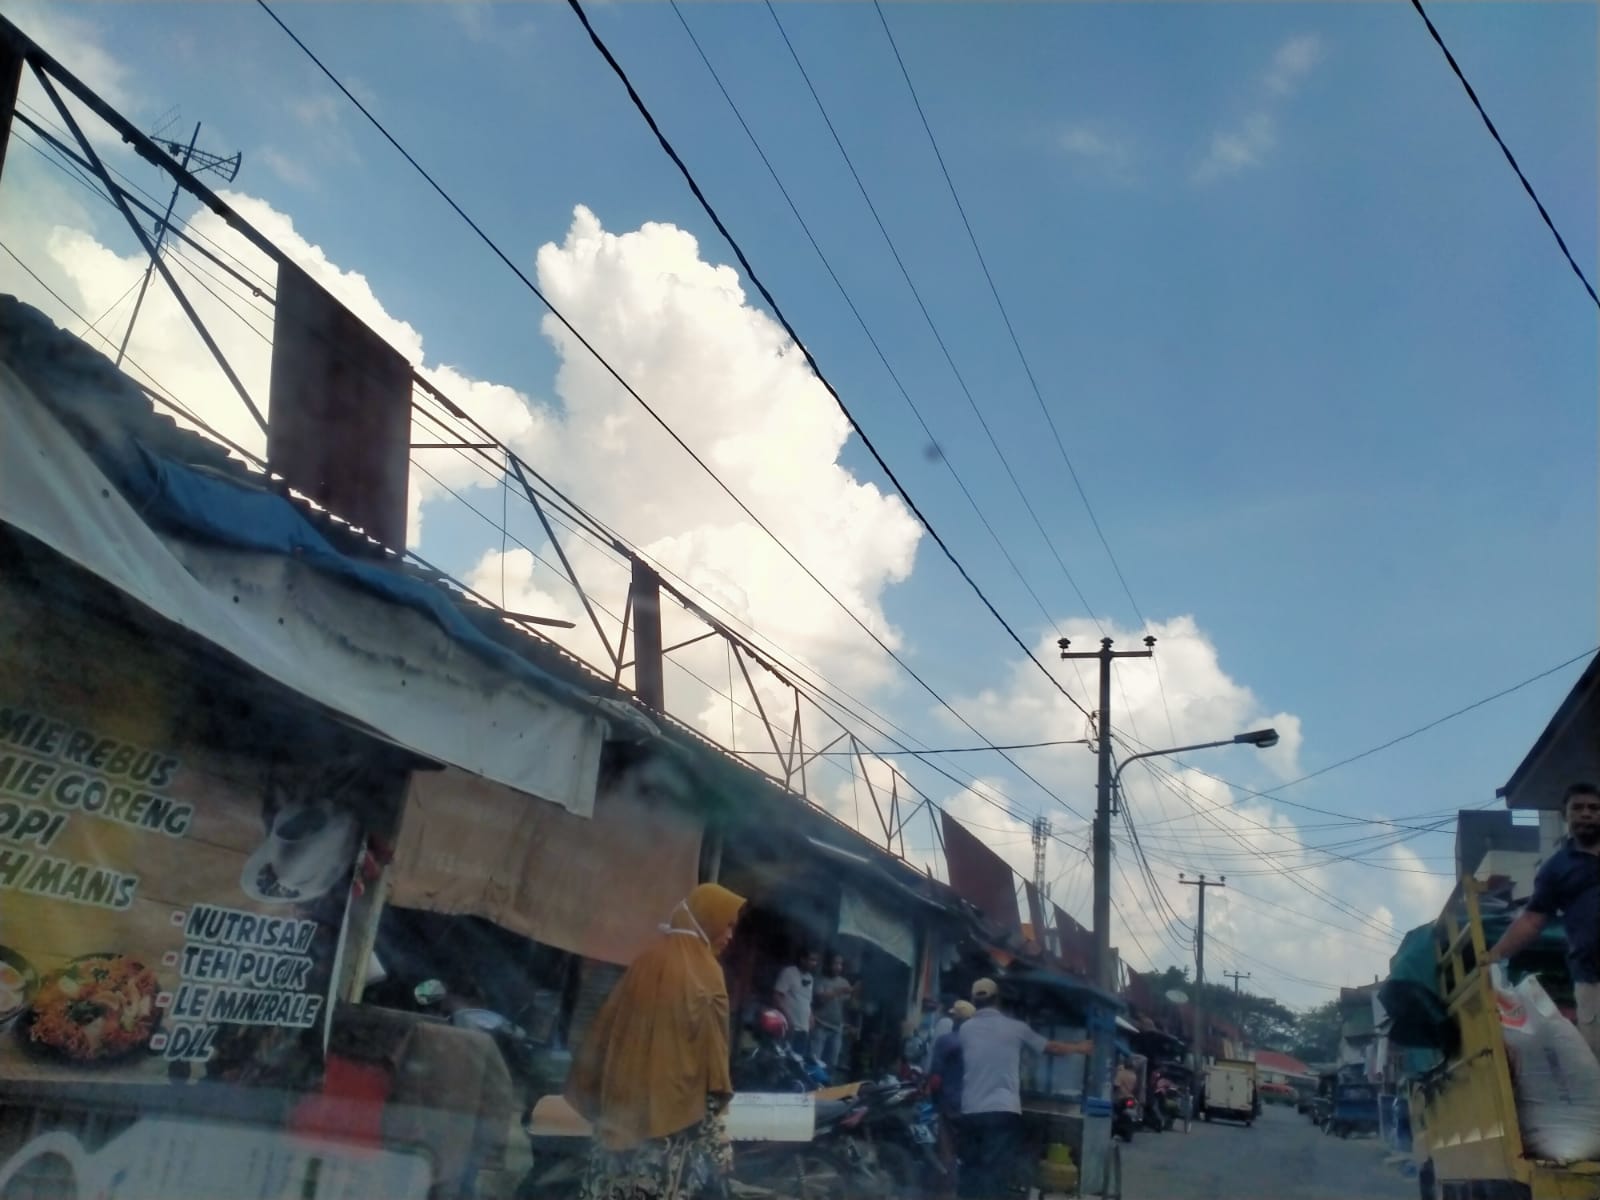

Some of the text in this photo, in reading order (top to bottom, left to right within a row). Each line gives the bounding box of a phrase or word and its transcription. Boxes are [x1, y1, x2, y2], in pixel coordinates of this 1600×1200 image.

[0, 707, 178, 787] MIE REBUS
[55, 774, 192, 835] GORENG
[25, 860, 137, 907] MANIS
[187, 906, 315, 950] NUTRISARI
[182, 946, 231, 978] TEH
[172, 985, 320, 1025] LE MINERALE
[166, 1026, 216, 1059] DLL
